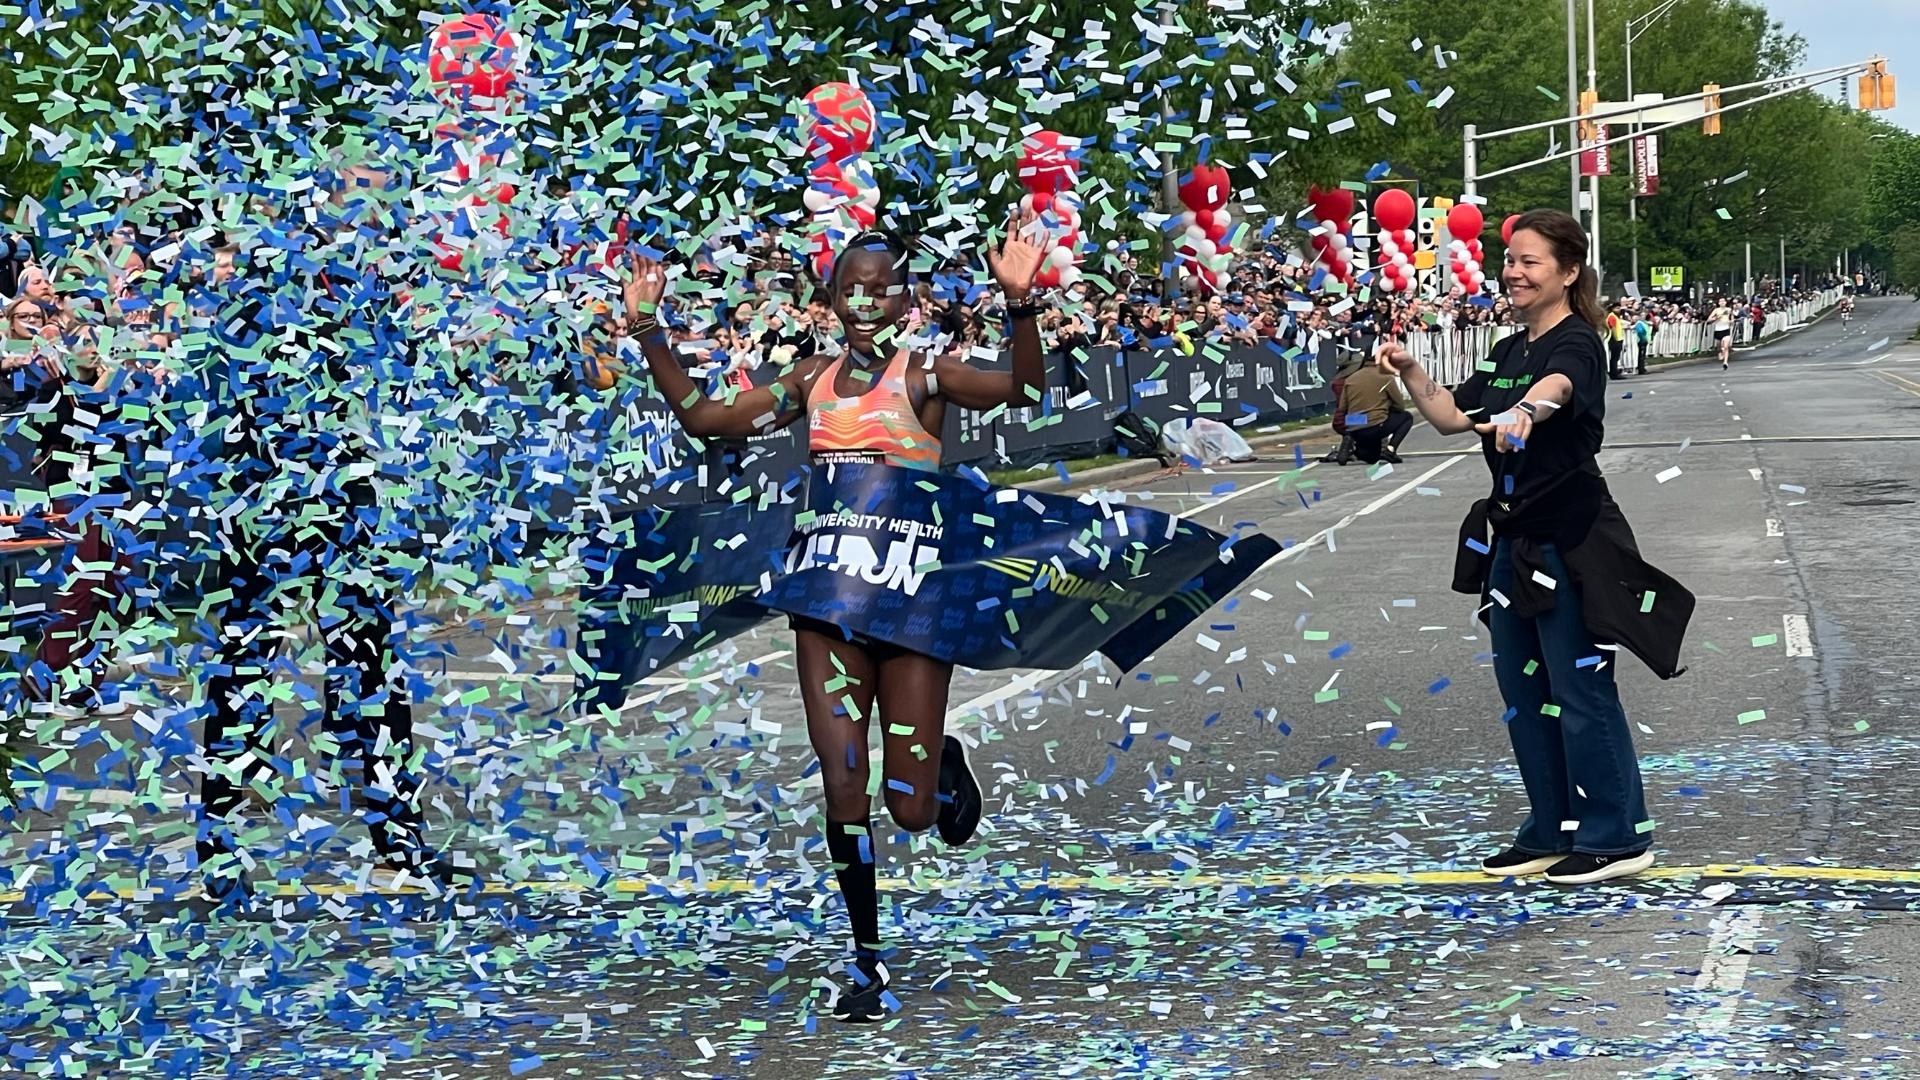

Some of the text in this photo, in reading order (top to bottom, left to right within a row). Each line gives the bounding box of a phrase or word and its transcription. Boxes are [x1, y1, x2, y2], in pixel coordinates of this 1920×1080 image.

[1637, 138, 1648, 194] INDIANAPOLIS
[1655, 267, 1679, 275] MILE
[1662, 273, 1672, 290] 3
